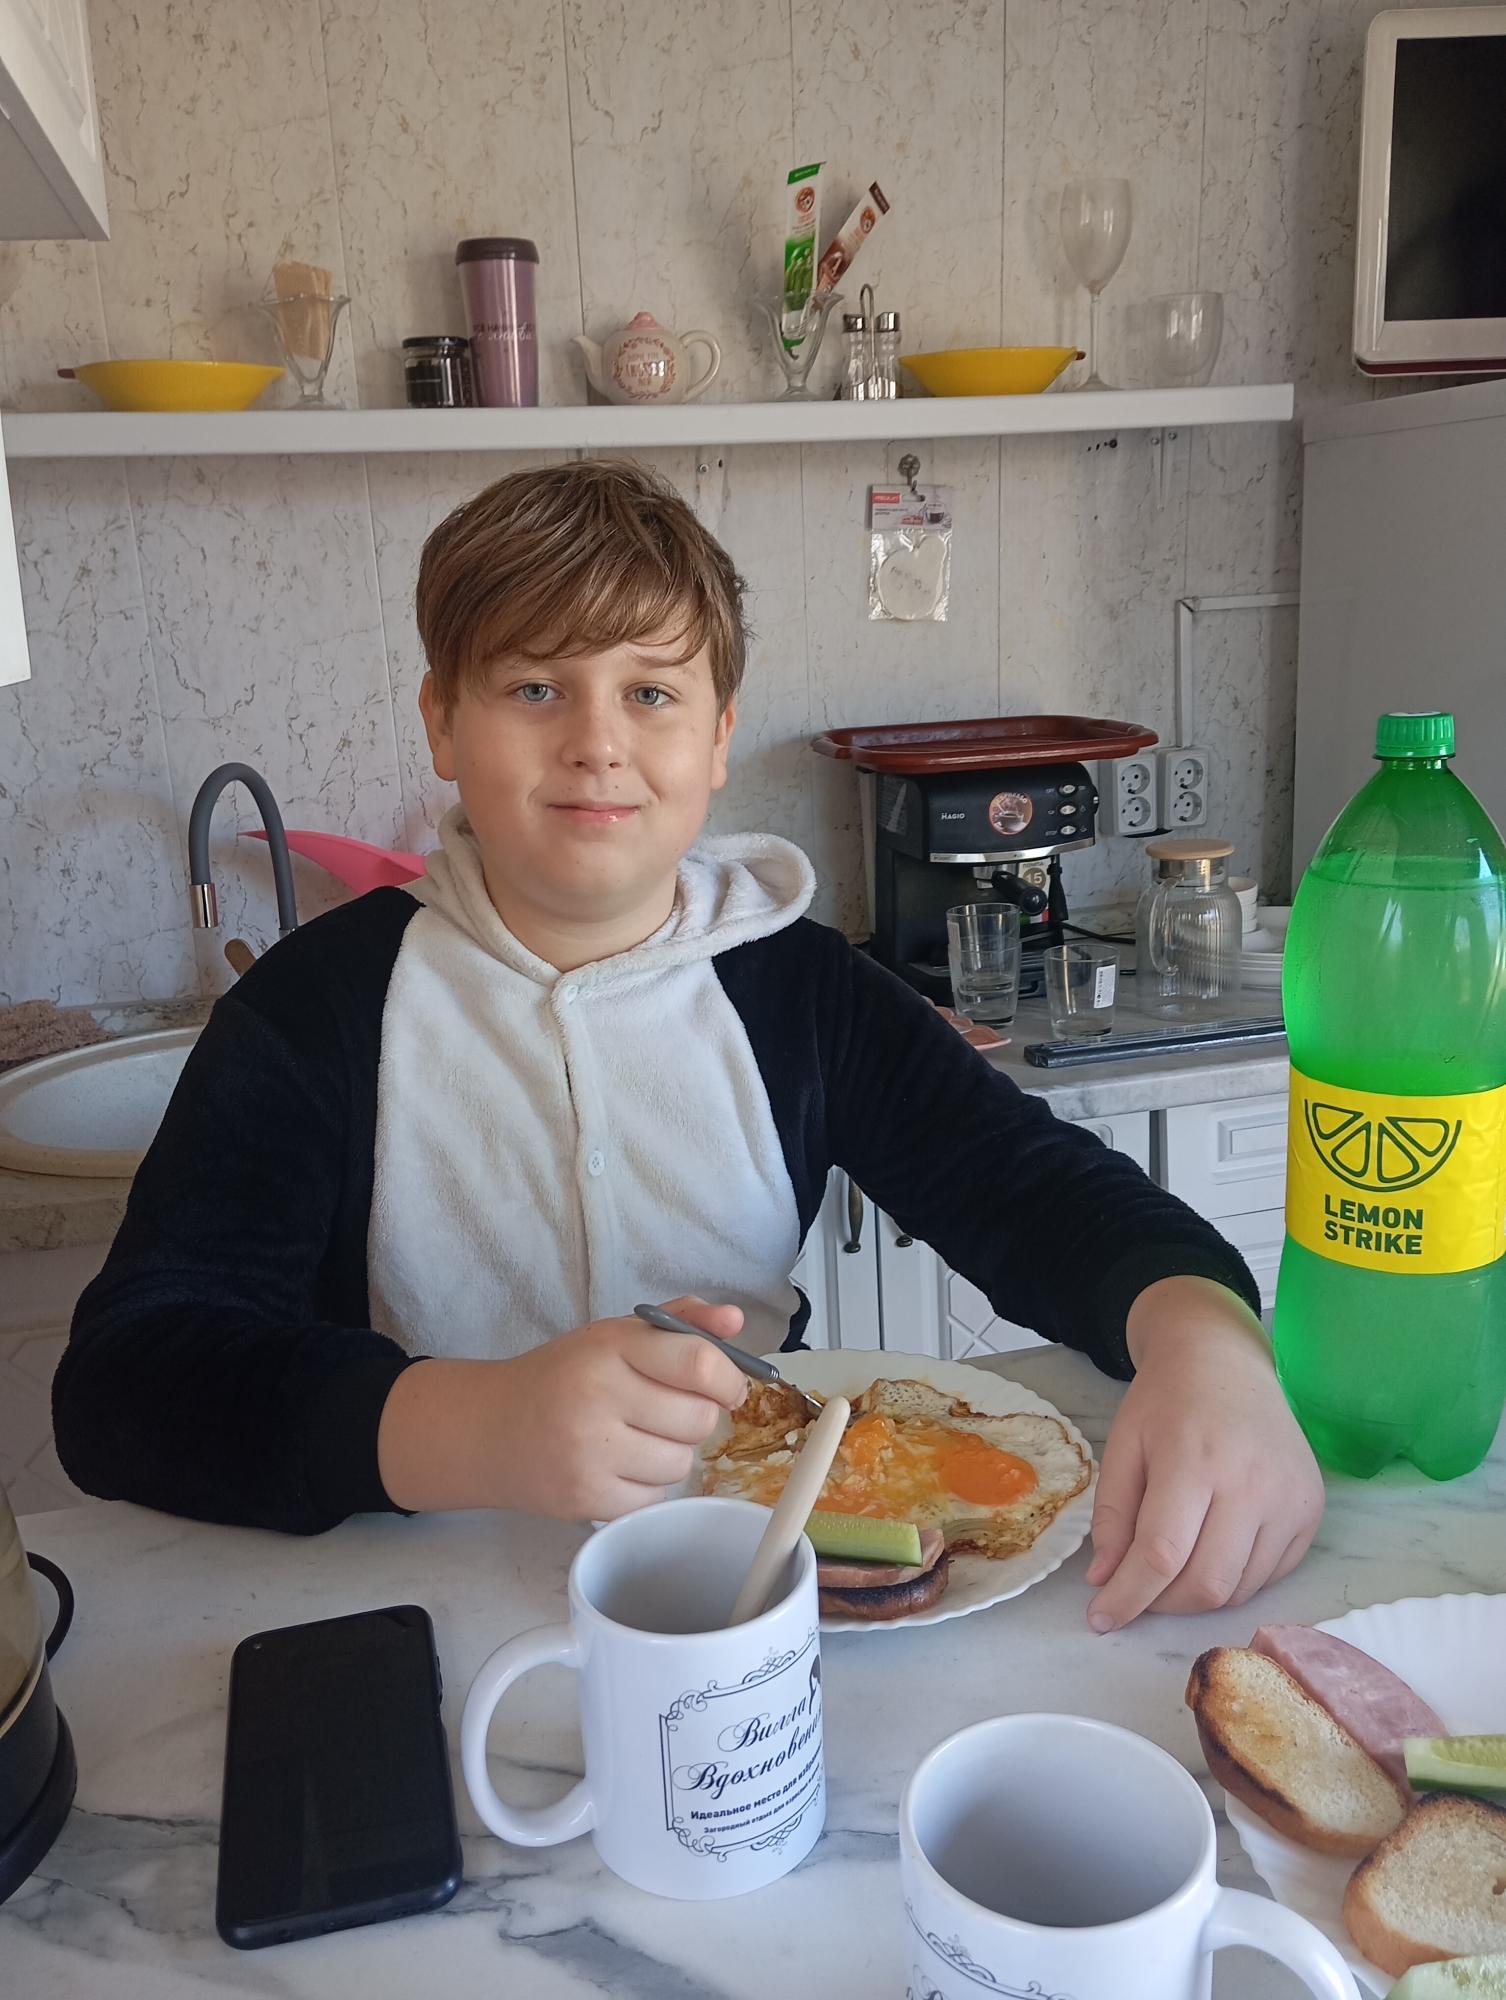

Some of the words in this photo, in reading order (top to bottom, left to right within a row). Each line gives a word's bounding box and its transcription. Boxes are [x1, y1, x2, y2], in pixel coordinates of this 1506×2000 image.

[1024, 872, 1042, 885] 15
[1324, 1194, 1423, 1229] LEMON
[1324, 1220, 1423, 1255] STRIKE
[717, 1696, 807, 1752] Вилла
[690, 1802, 752, 1820] Идеальное
[753, 1789, 782, 1808] место
[782, 1777, 798, 1794] для
